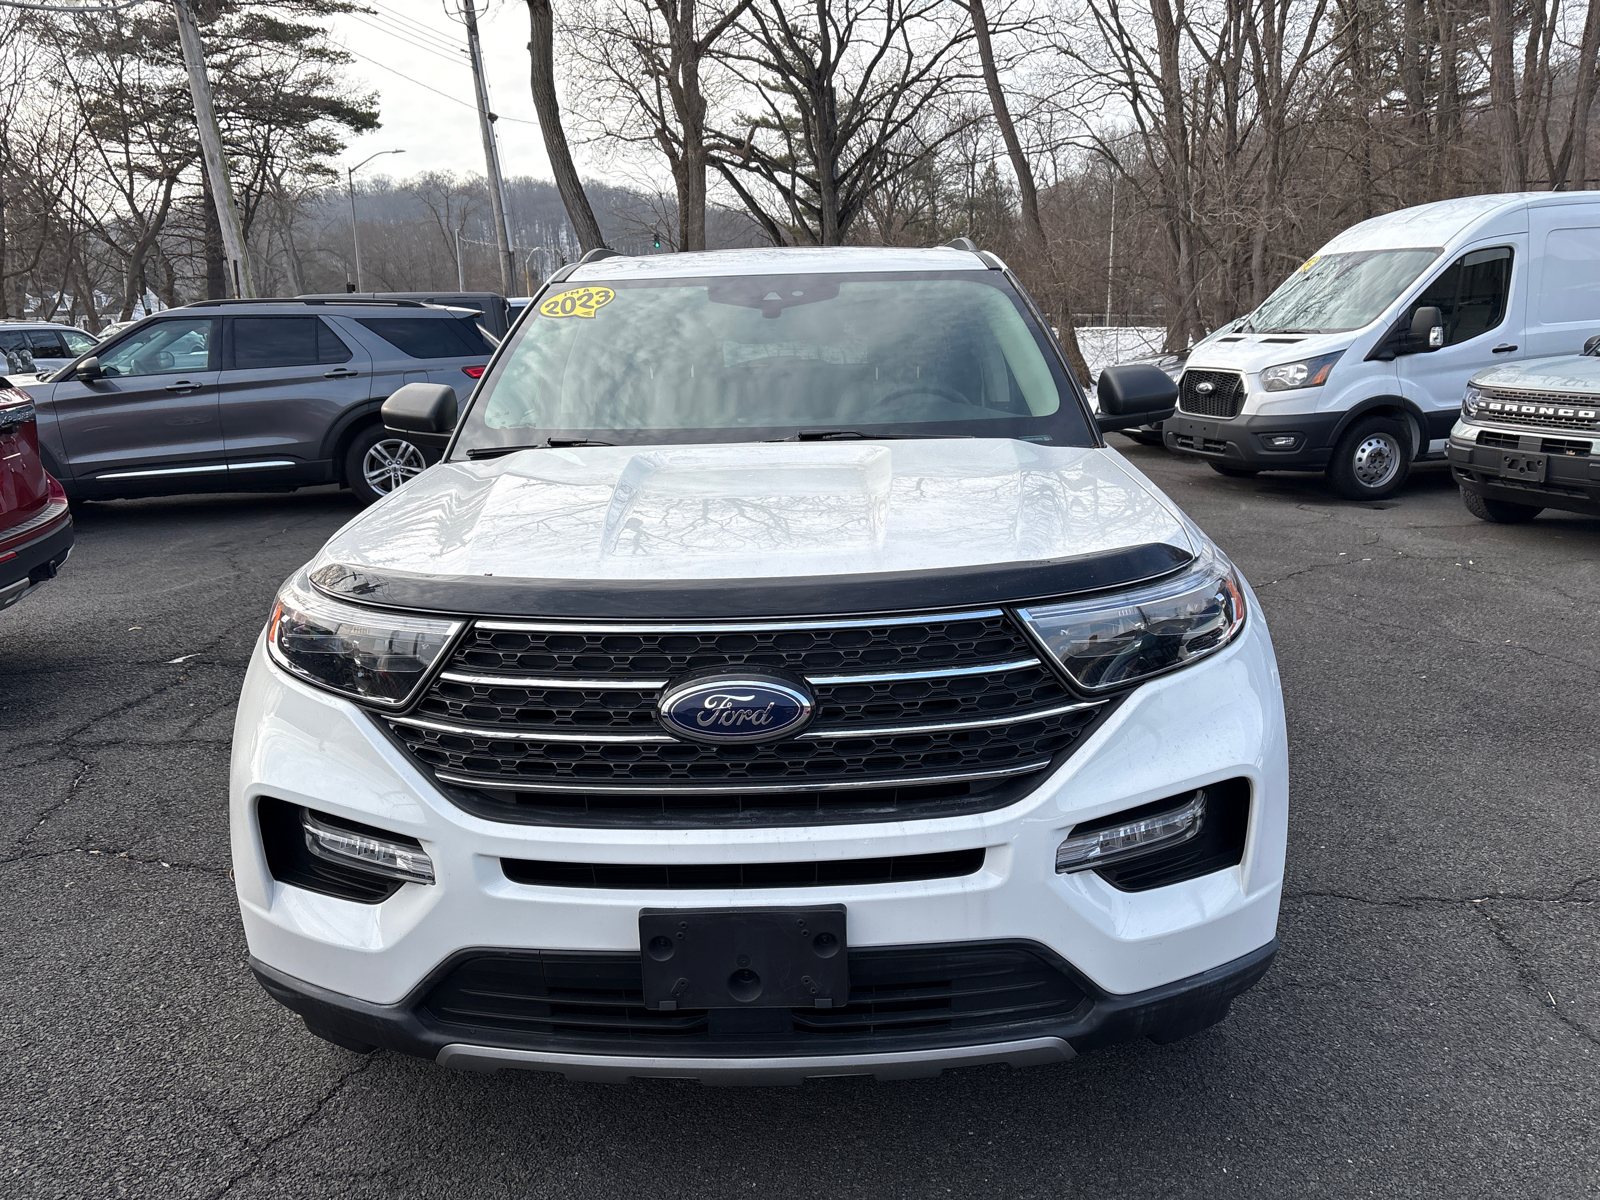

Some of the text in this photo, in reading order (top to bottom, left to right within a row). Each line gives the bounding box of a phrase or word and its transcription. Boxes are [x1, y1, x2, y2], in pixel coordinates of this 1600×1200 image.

[545, 290, 611, 315] 2023
[1489, 402, 1596, 418] BRONCO
[696, 694, 775, 727] Ford
